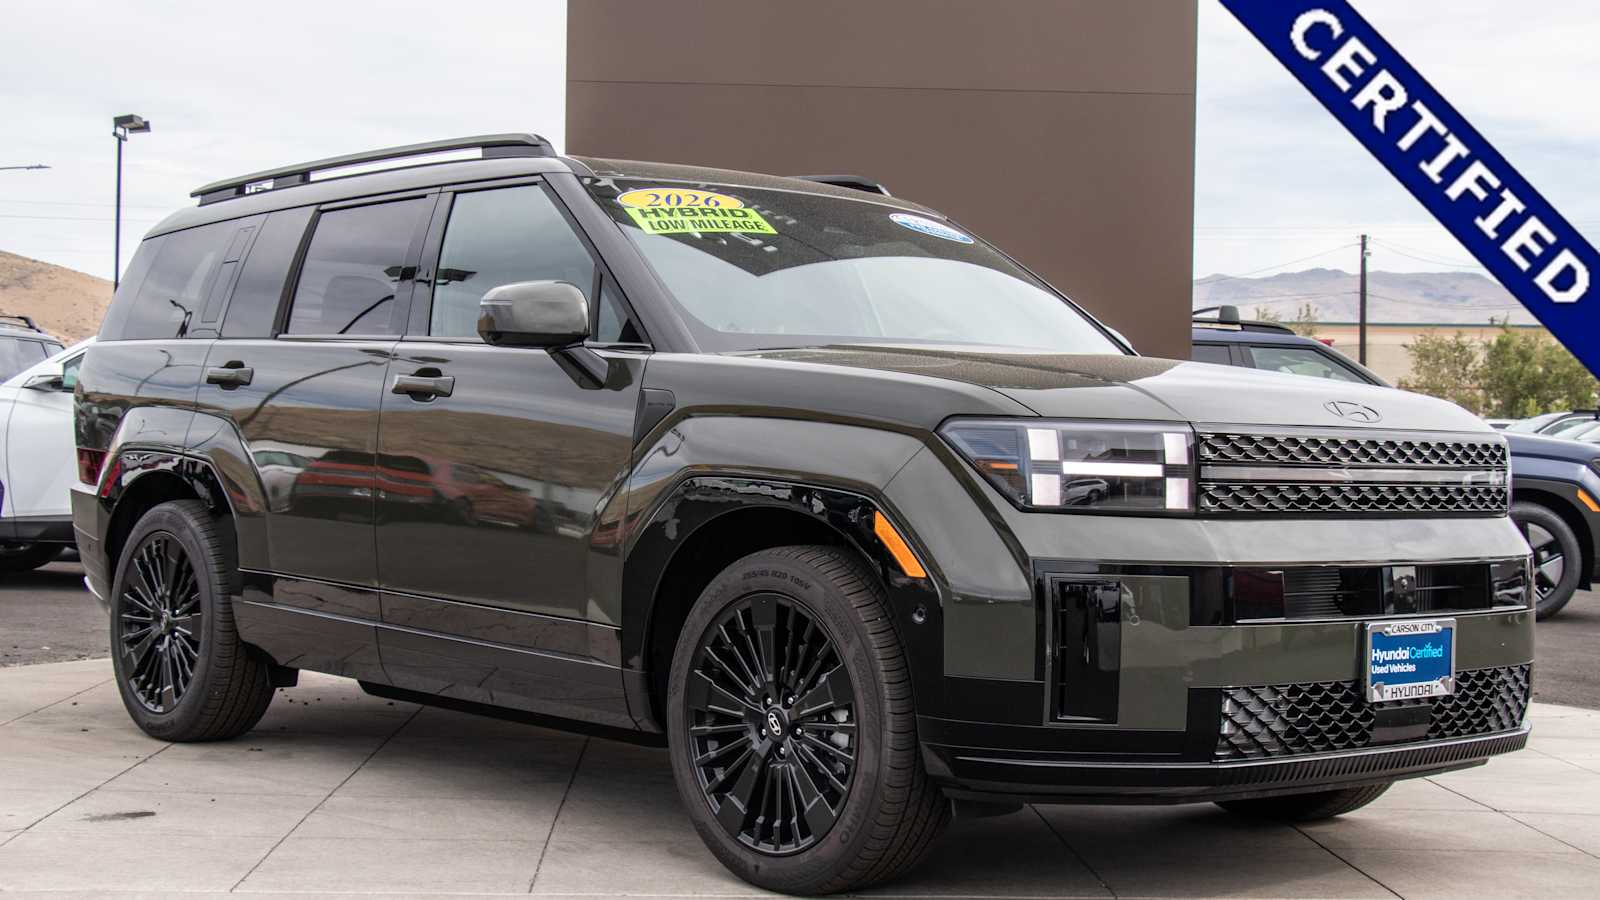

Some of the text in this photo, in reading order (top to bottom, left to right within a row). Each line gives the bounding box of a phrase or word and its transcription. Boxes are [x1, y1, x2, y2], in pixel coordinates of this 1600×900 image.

[646, 193, 721, 208] 2026
[638, 207, 749, 218] HYBRID
[648, 219, 766, 231] LOW MILEAGE
[1391, 623, 1434, 633] CARSON CITY
[1371, 647, 1410, 663] Hyundai
[1371, 663, 1416, 674] Used Vehicles
[1391, 685, 1433, 698] HYUNDAI
